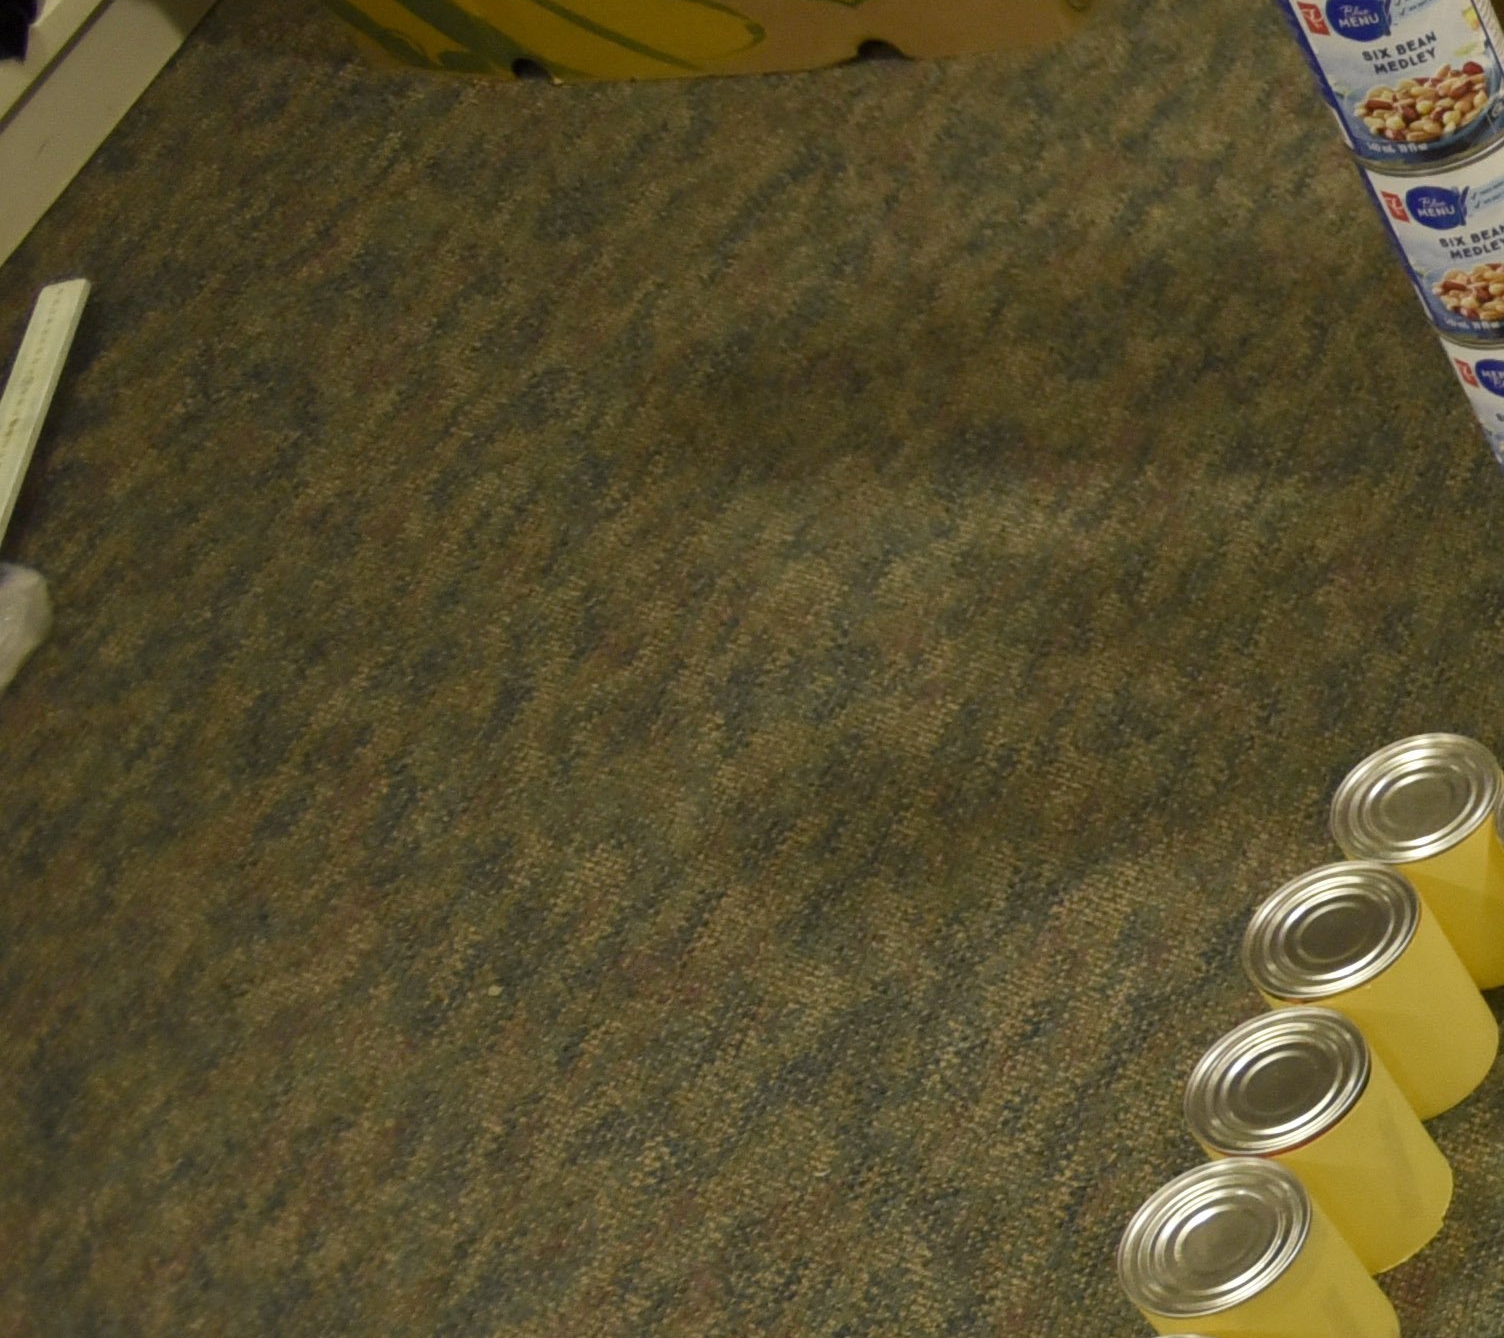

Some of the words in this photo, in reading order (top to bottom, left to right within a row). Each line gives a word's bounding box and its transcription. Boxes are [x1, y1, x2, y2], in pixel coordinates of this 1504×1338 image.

[1338, 12, 1380, 28] MENU
[1362, 47, 1393, 63] SIX
[1397, 32, 1438, 58] BEAN
[1373, 47, 1437, 75] MEDLEY
